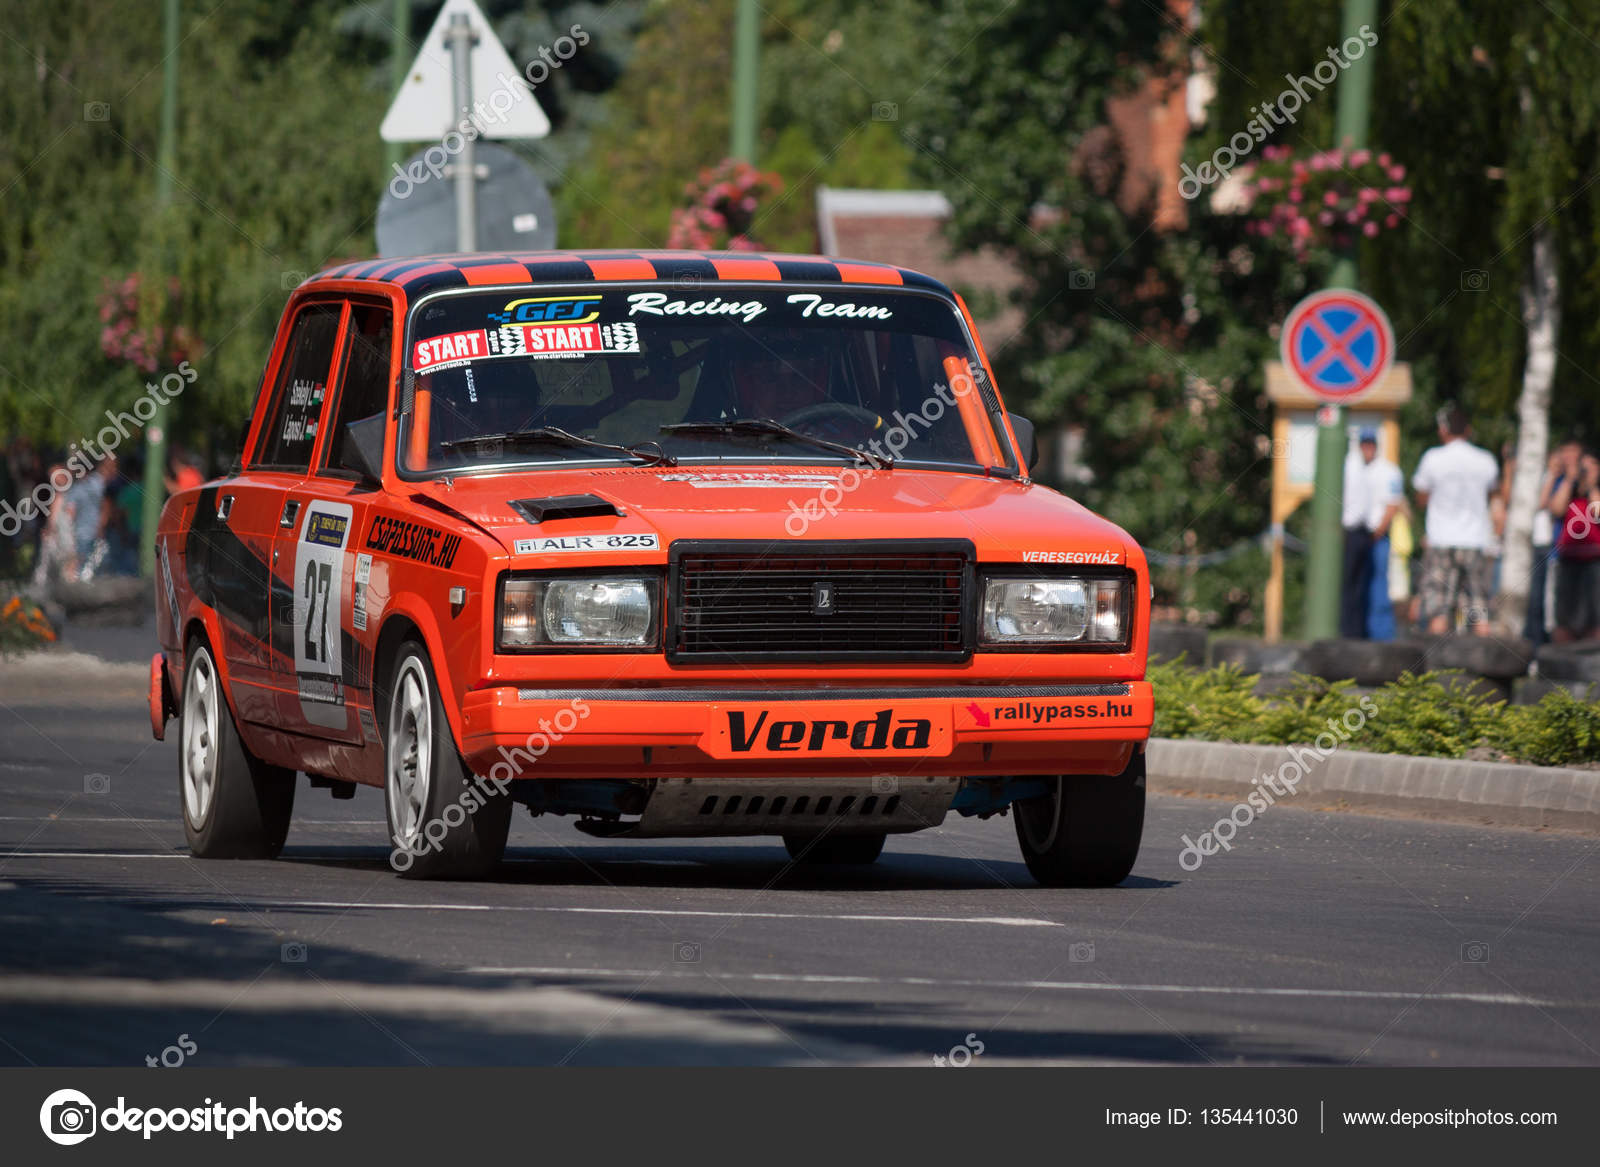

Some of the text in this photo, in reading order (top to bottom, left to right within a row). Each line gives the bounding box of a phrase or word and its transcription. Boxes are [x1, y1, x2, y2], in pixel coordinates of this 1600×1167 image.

[627, 293, 903, 323] Racing Team
[417, 333, 480, 365] START
[531, 326, 594, 350] START
[542, 535, 655, 550] ALR-825
[1022, 550, 1120, 564] VERESEGYHÁZ
[304, 559, 333, 663] 27
[994, 701, 1132, 723] rallypass.hu
[727, 709, 931, 752] Verda
